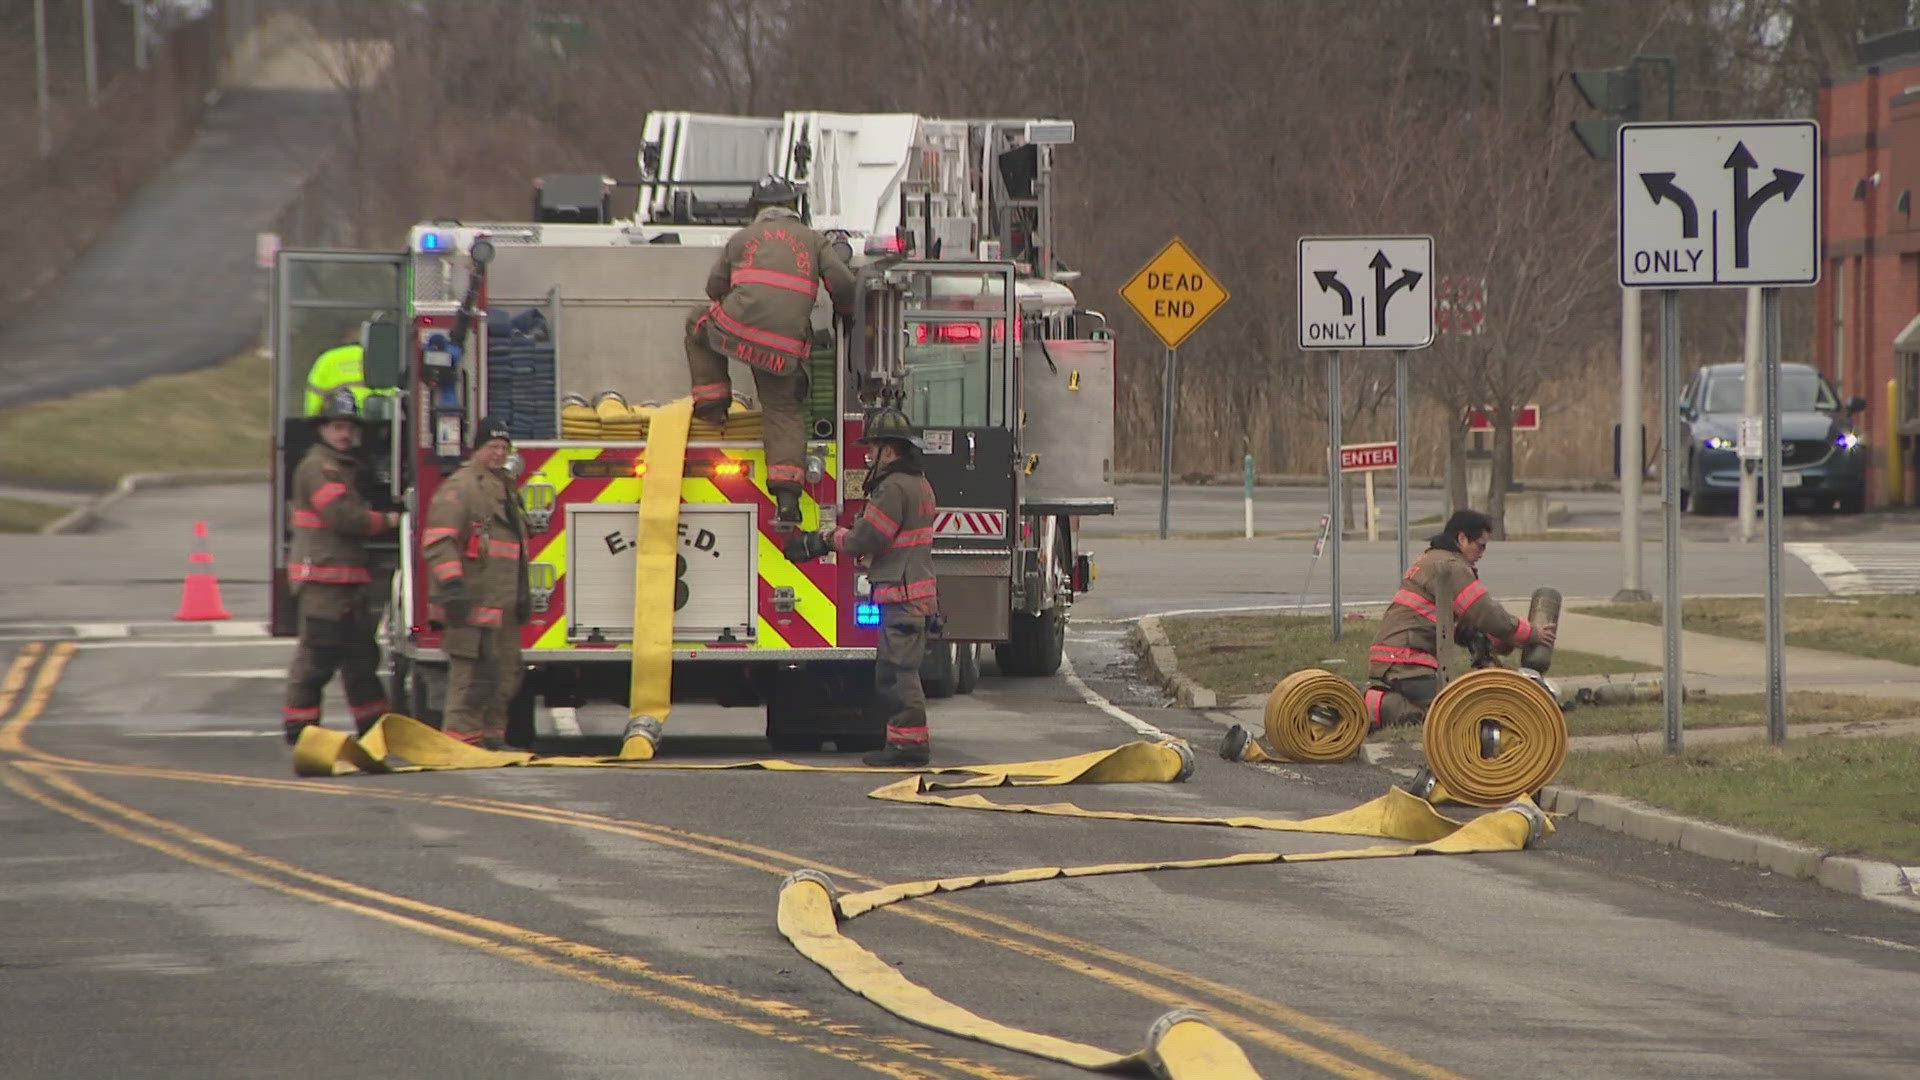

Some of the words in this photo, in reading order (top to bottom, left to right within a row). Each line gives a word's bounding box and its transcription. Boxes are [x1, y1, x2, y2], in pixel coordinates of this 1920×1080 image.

[1634, 249, 1704, 274] ONLY
[1147, 272, 1204, 292] DEAD
[1154, 299, 1195, 318] END
[1309, 322, 1356, 340] ONLY
[1342, 448, 1394, 466] ENTER
